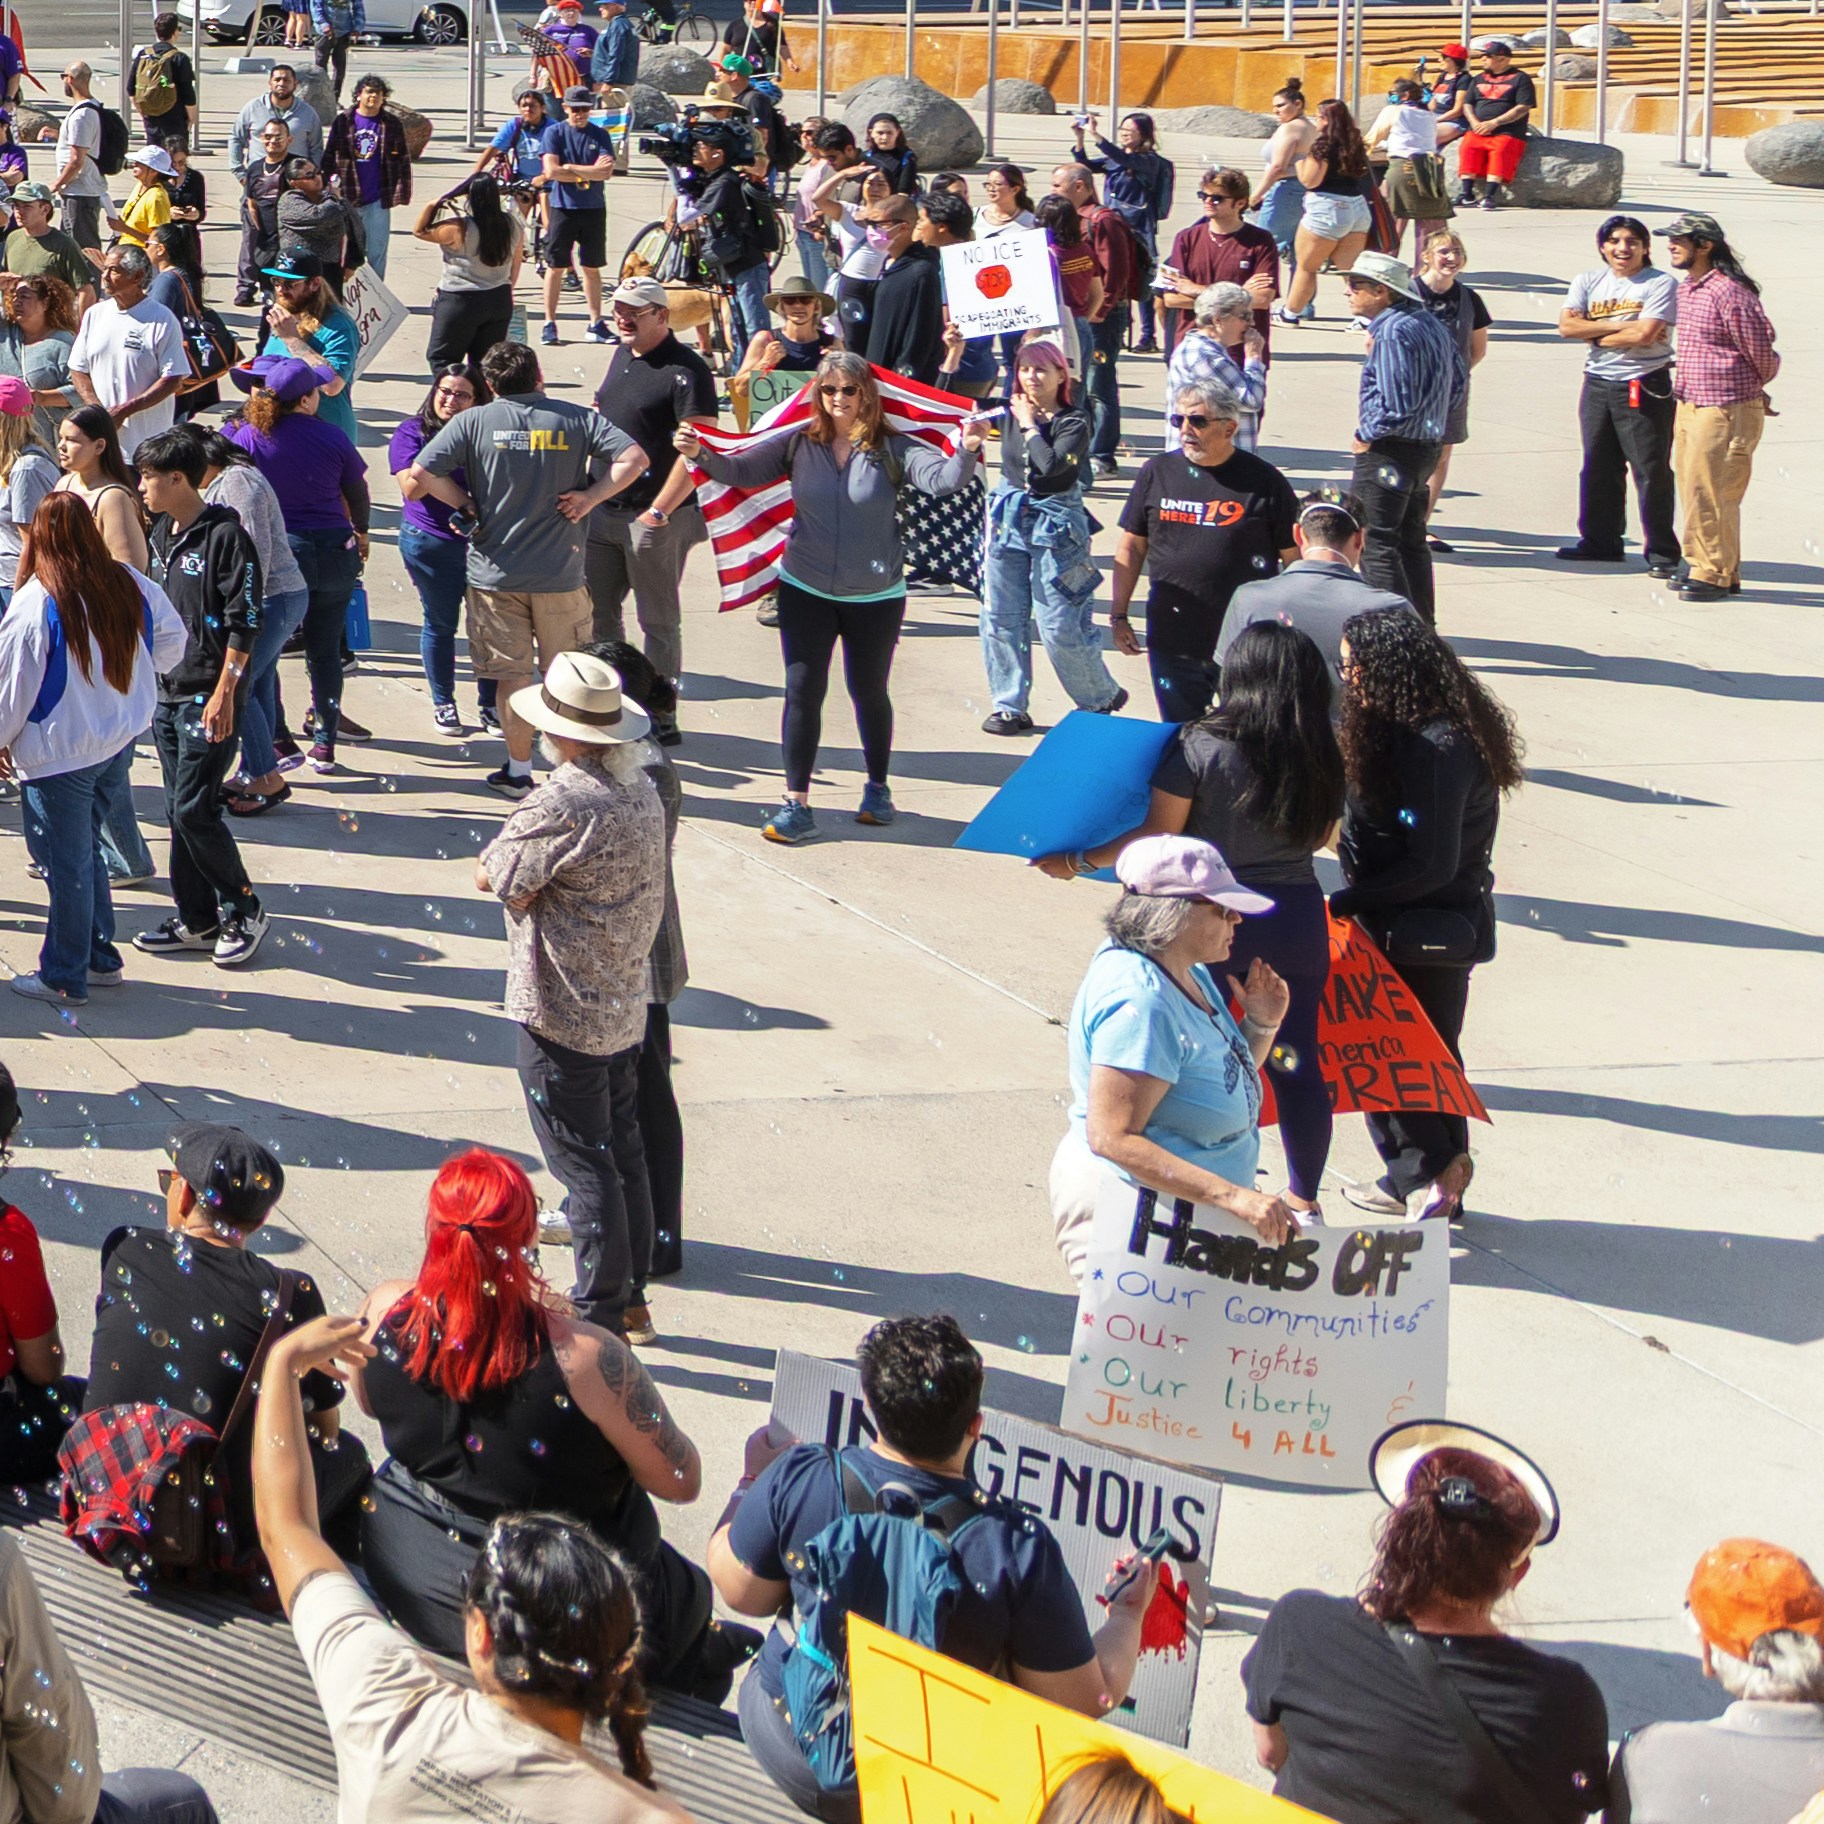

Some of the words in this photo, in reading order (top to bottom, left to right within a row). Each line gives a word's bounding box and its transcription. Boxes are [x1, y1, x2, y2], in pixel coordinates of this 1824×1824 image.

[964, 247, 991, 264] NO
[995, 242, 1023, 259] ICE
[981, 314, 1043, 332] IMMIGRANTS
[493, 430, 530, 441] UNITED
[509, 441, 530, 450] FOR
[530, 429, 569, 451] ALL
[1160, 498, 1203, 514] UNITE
[1204, 500, 1245, 526] 19
[1129, 1186, 1320, 1291] Hands
[1332, 1228, 1425, 1300] OFF
[1117, 1270, 1206, 1318] Our
[1224, 1295, 1434, 1340] Communities
[1107, 1312, 1189, 1360] Our
[1230, 1340, 1320, 1383] rights
[1103, 1356, 1190, 1400] Our
[1224, 1376, 1332, 1432] liberty
[1085, 1389, 1204, 1441] Justice
[1232, 1420, 1251, 1451] 4
[1273, 1430, 1337, 1458] ALL
[827, 1392, 1203, 1564] INGENOUS
